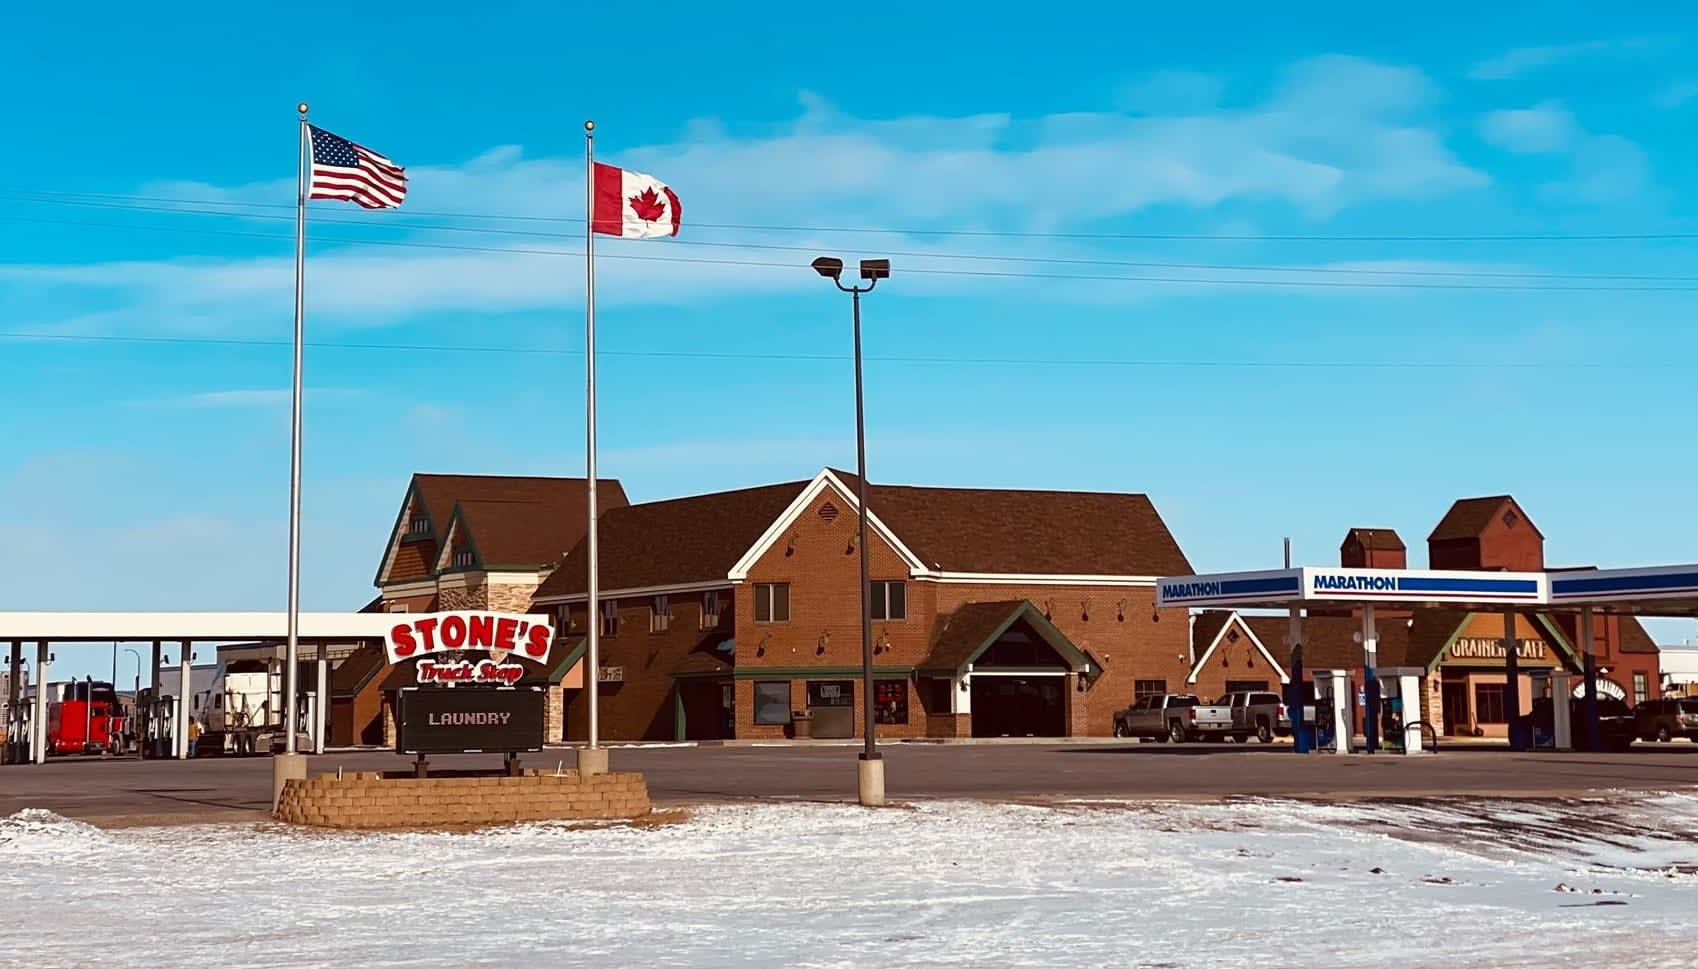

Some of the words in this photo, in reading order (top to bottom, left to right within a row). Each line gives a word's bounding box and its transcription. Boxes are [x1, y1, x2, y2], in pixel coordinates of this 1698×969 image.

[1162, 582, 1220, 598] MARATHON
[1314, 575, 1396, 591] MARATHON
[391, 615, 549, 657] STONE'S
[1451, 639, 1507, 657] GRAINER
[418, 661, 475, 682] Truck
[476, 661, 522, 684] Stop
[428, 712, 511, 726] LAUNDRY
